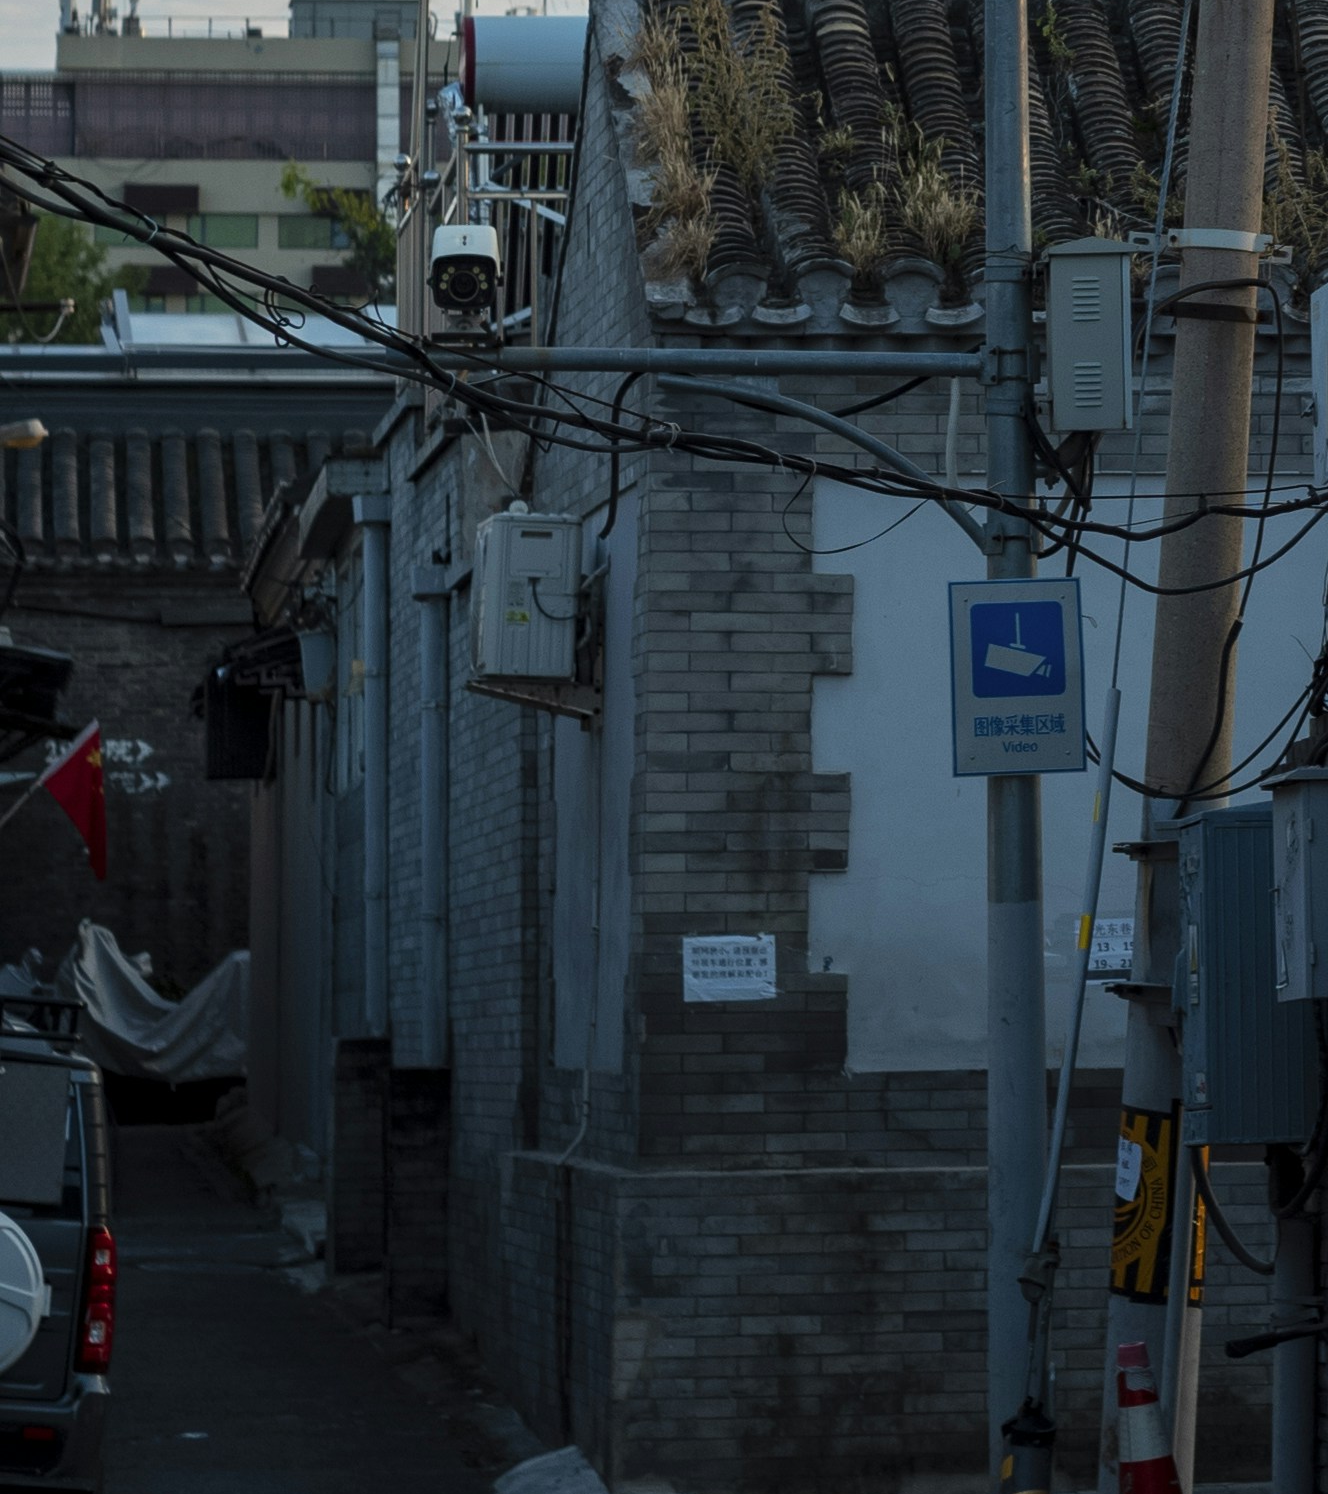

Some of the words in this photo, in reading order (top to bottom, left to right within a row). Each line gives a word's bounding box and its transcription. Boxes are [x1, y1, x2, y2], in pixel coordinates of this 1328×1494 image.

[974, 713, 1066, 737] 图像采集区域
[1003, 741, 1038, 753] Video
[1093, 923, 1132, 936] 光东巷
[1140, 1220, 1155, 1240] OF
[1149, 1178, 1165, 1220] CHINA
